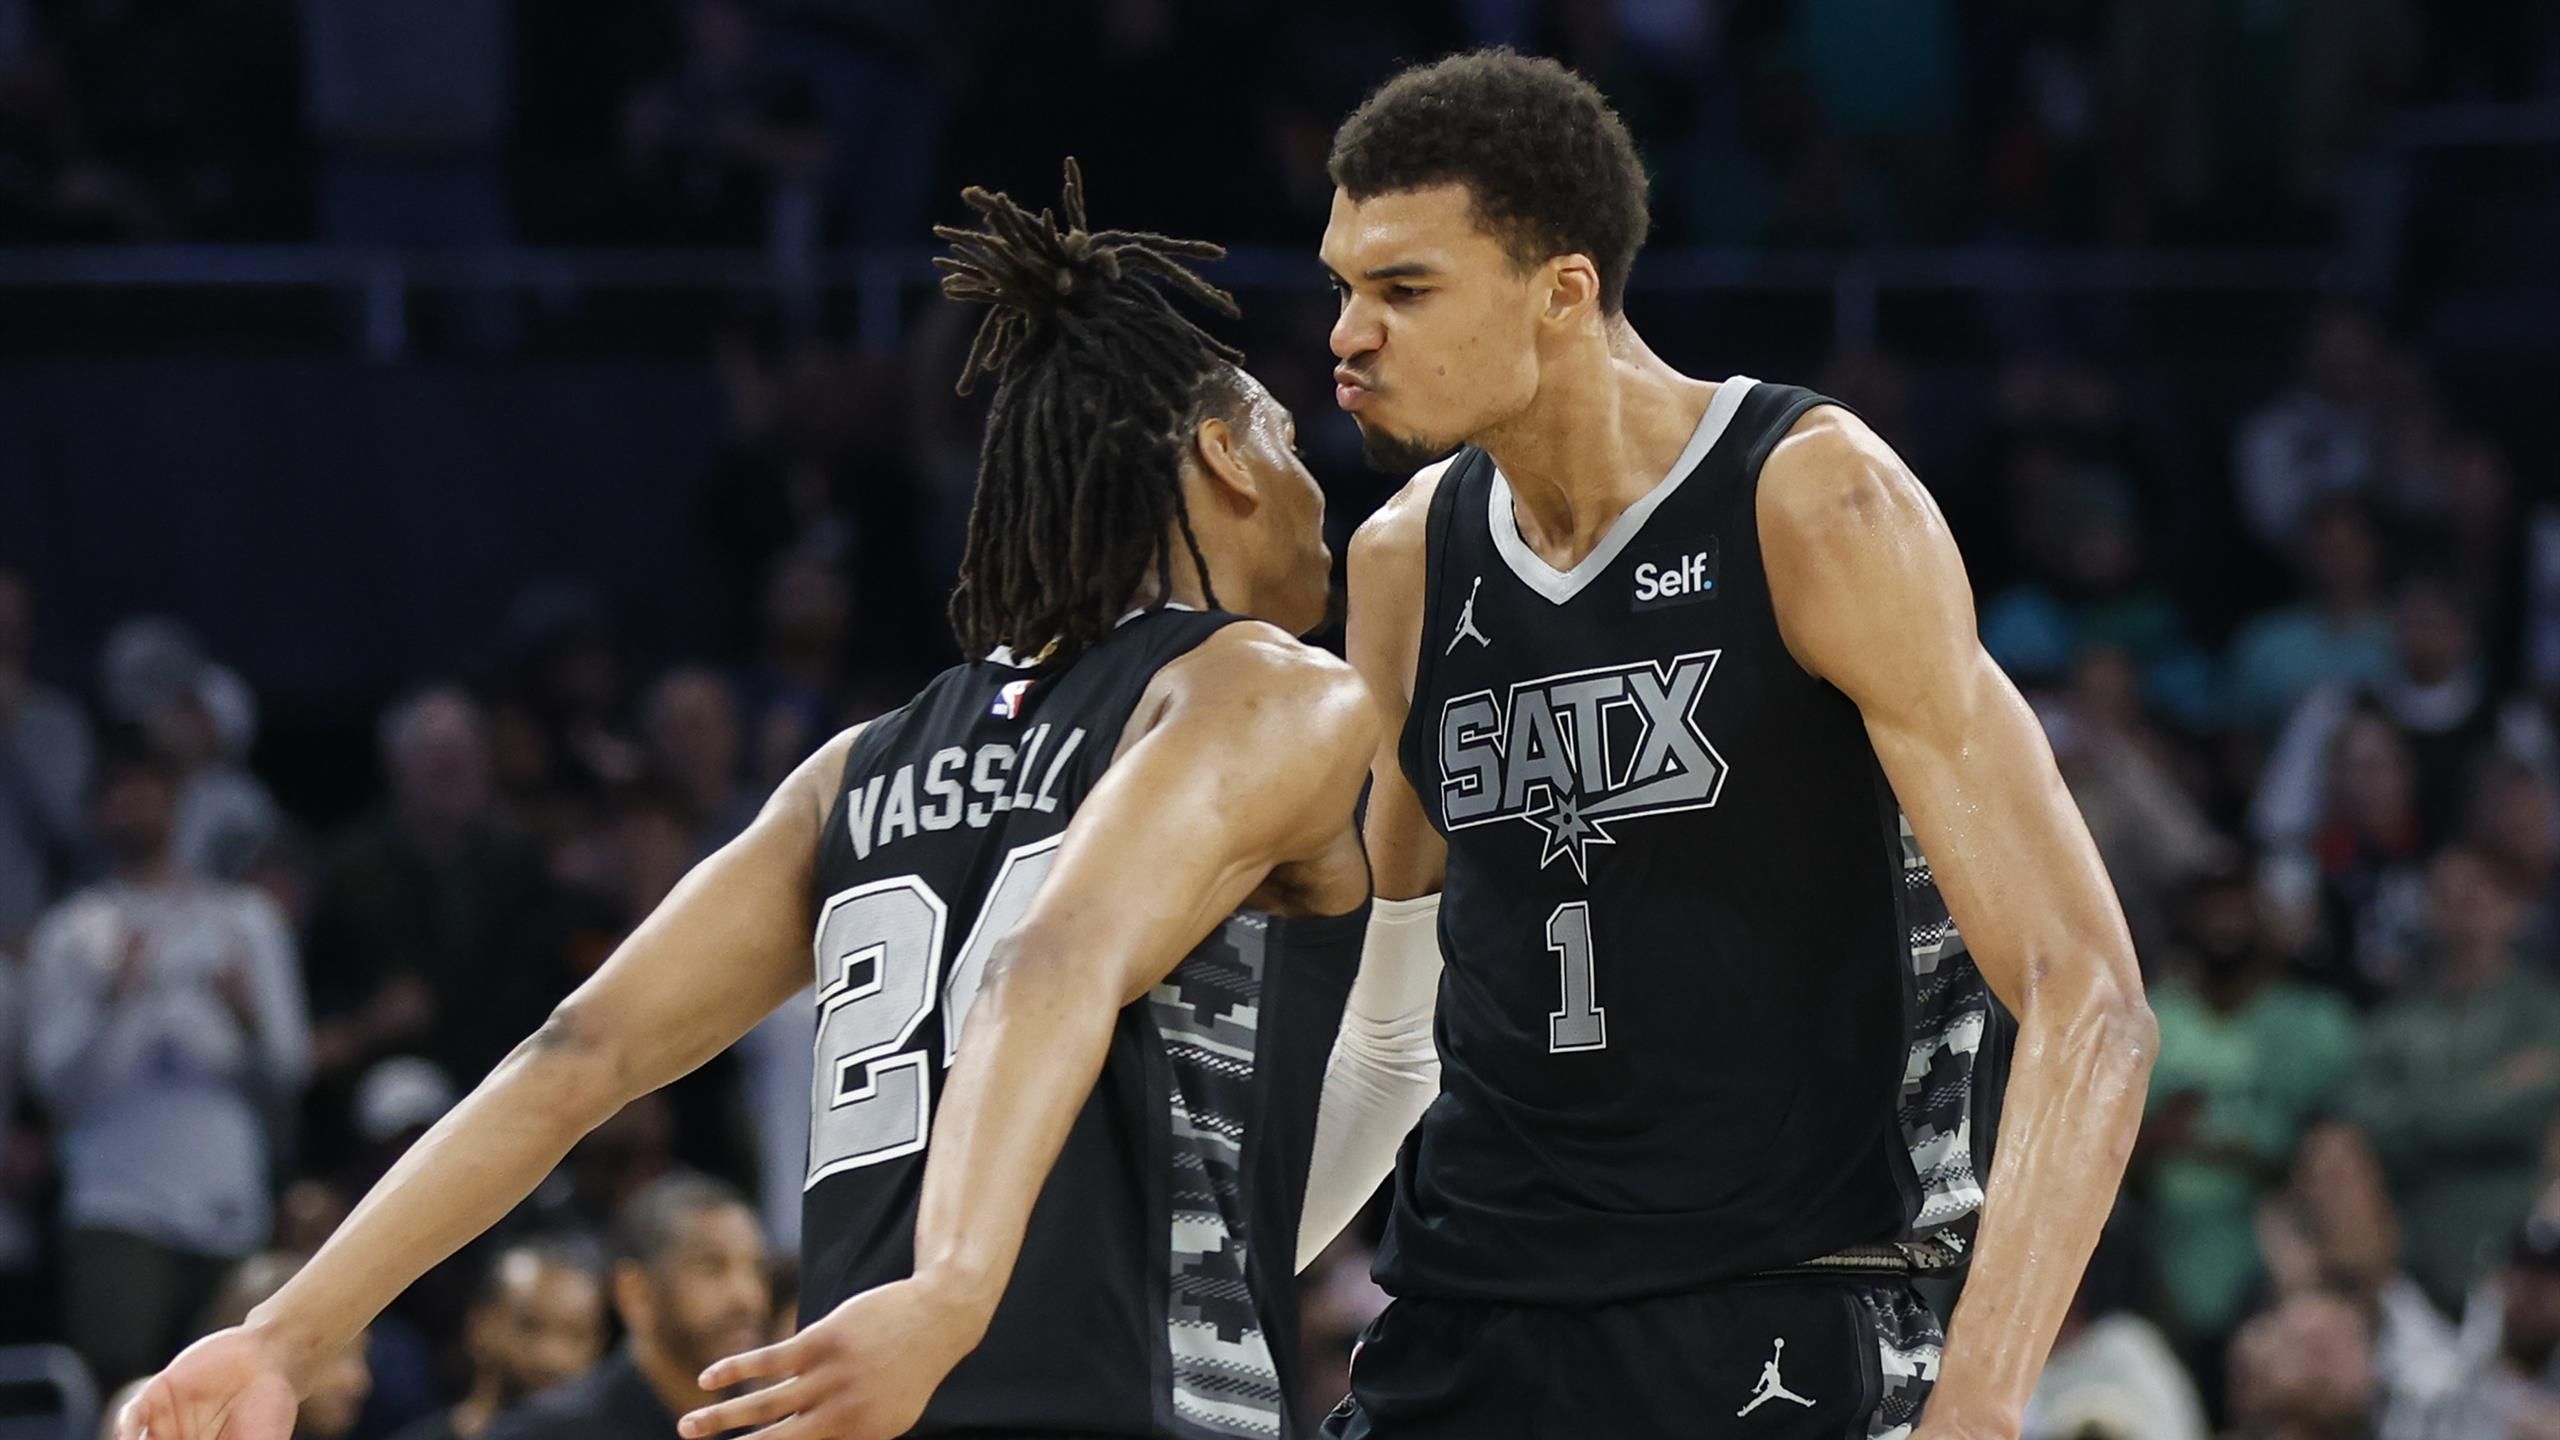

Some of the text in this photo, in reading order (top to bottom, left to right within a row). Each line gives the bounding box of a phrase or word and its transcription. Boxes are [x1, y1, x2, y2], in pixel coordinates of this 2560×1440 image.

[1634, 552, 1713, 602] Self.
[1439, 649, 1729, 832] SATX
[1546, 900, 1607, 1053] 1
